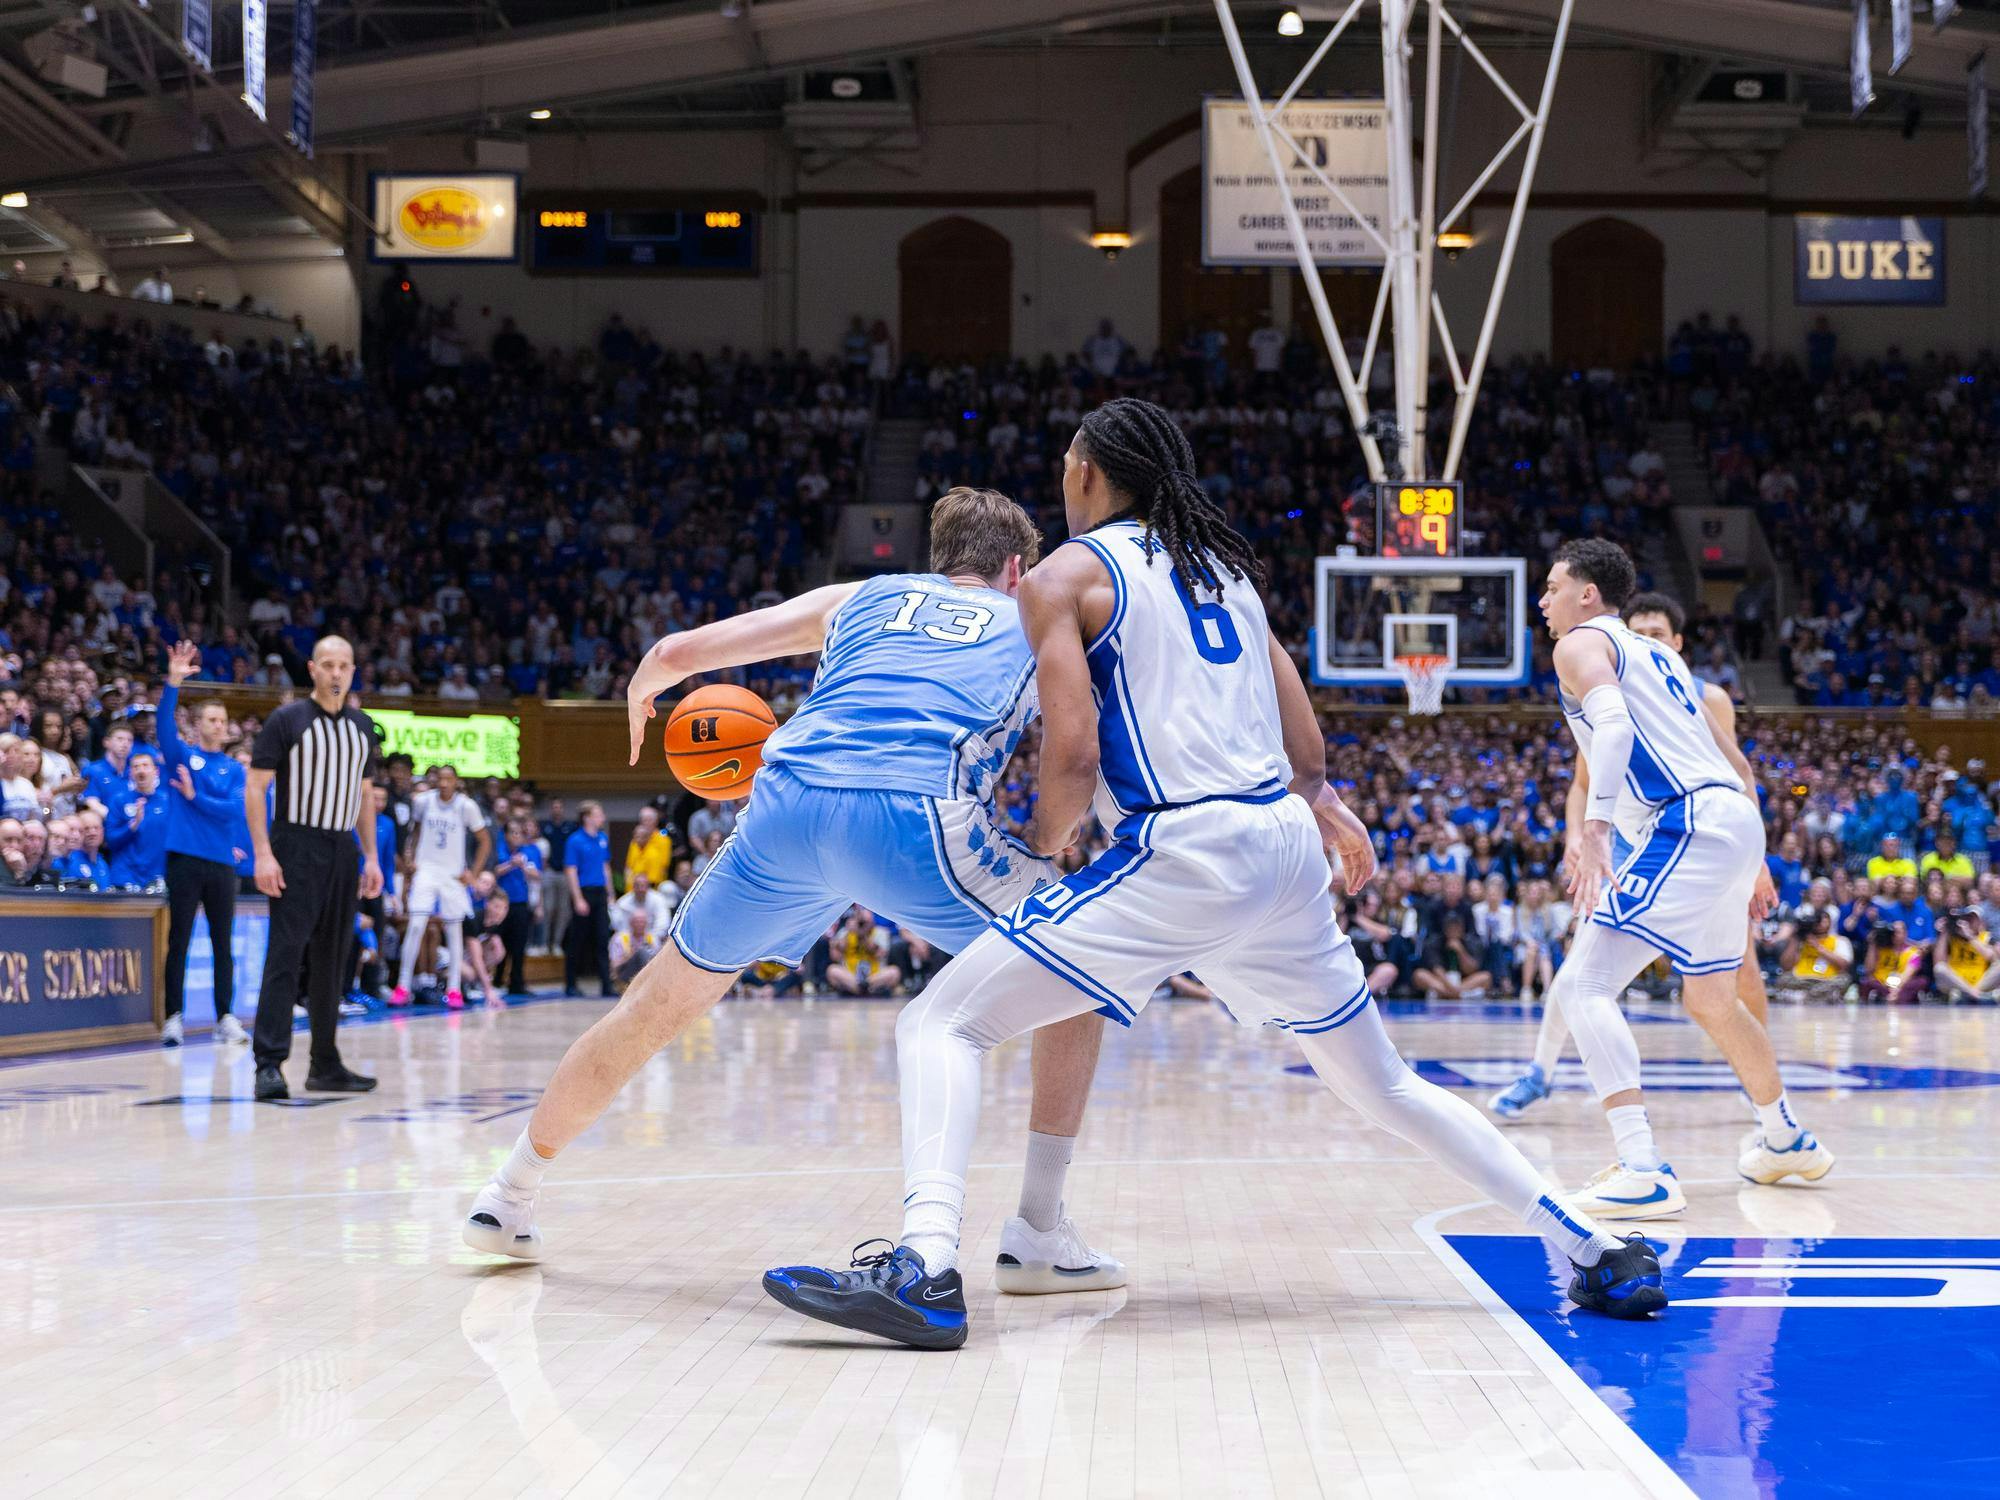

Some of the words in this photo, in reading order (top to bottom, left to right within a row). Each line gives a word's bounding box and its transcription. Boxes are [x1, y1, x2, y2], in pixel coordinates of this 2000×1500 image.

[540, 211, 587, 227] DUKE
[1239, 214, 1288, 231] CAREE
[1806, 240, 1935, 280] DUKE
[1399, 488, 1454, 515] 8:30
[1420, 514, 1447, 554] 9
[881, 590, 995, 644] 13
[1169, 564, 1243, 664] 6
[393, 727, 479, 751] wave
[43, 948, 142, 1000] STADIUM
